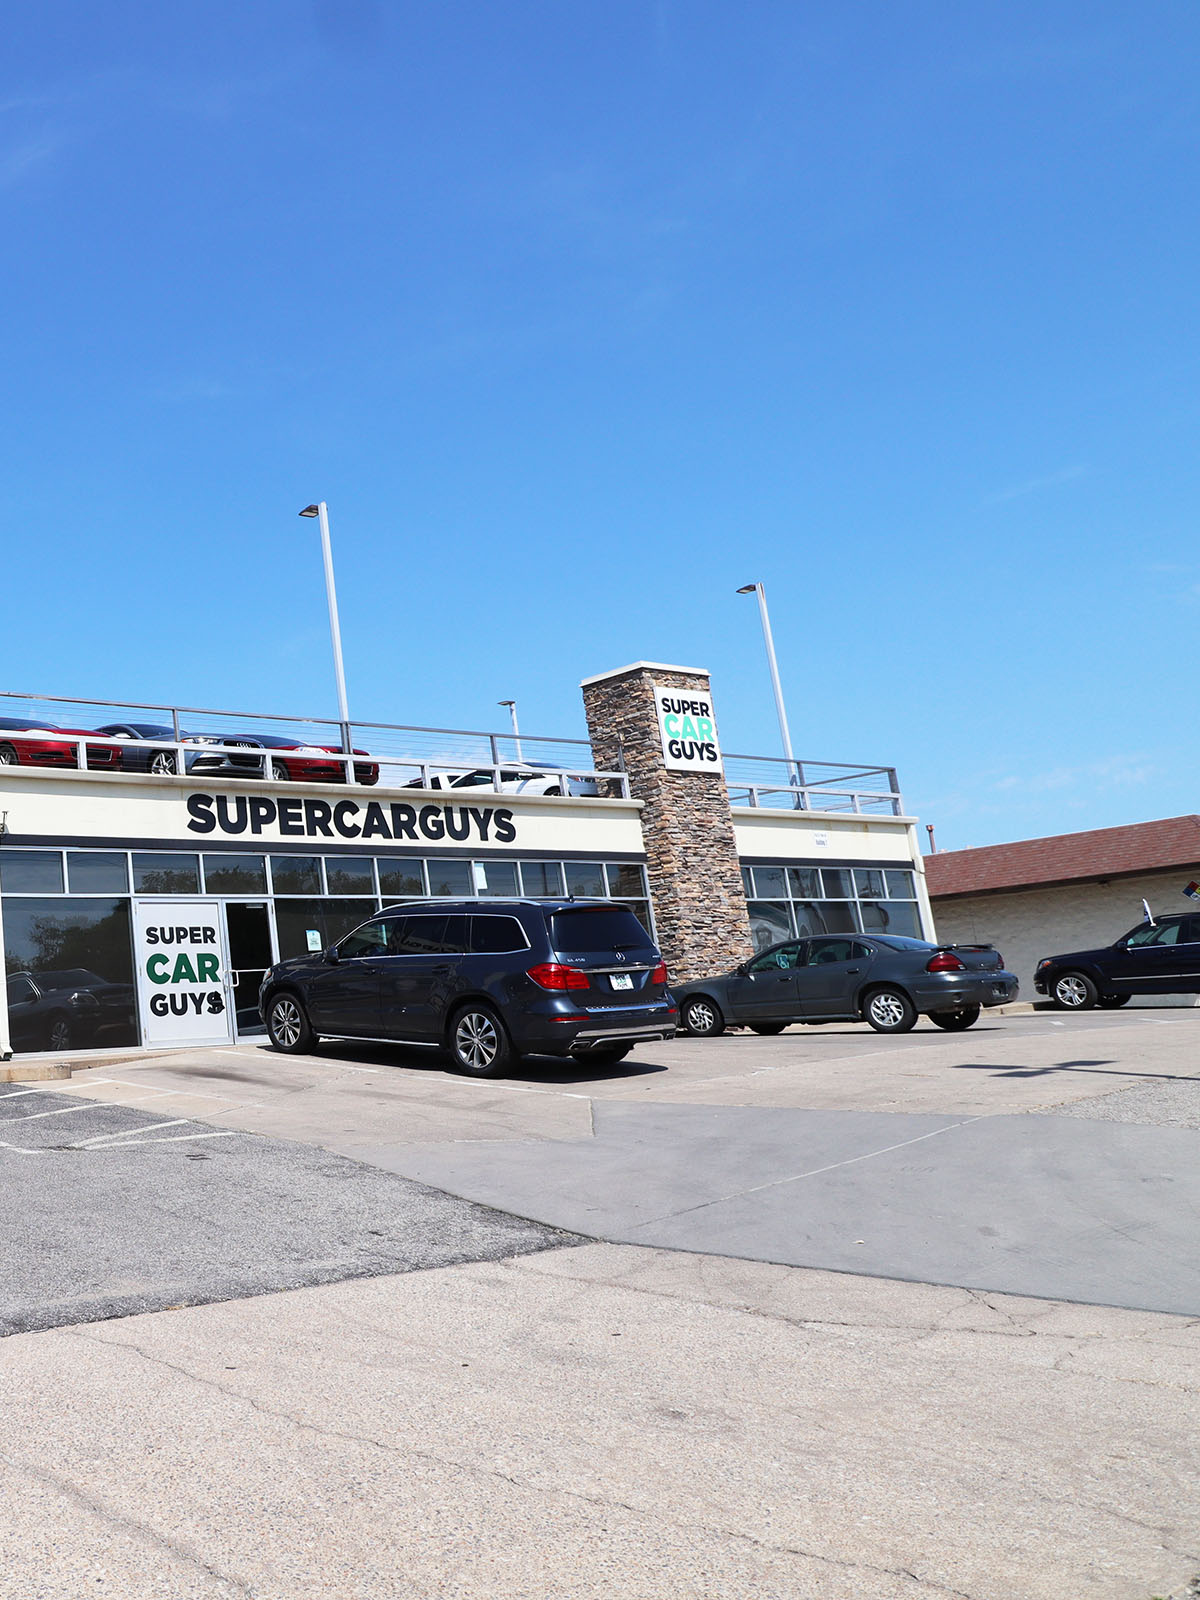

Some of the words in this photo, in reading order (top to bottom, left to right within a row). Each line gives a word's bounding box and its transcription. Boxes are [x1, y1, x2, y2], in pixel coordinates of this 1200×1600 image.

[661, 697, 710, 717] SUPER
[664, 713, 715, 742] CAR
[668, 739, 718, 762] GUYS
[187, 793, 517, 843] SUPERCARGUYS
[146, 926, 216, 945] SUPER
[146, 953, 221, 985] CAR
[150, 990, 224, 1017] GUYS
